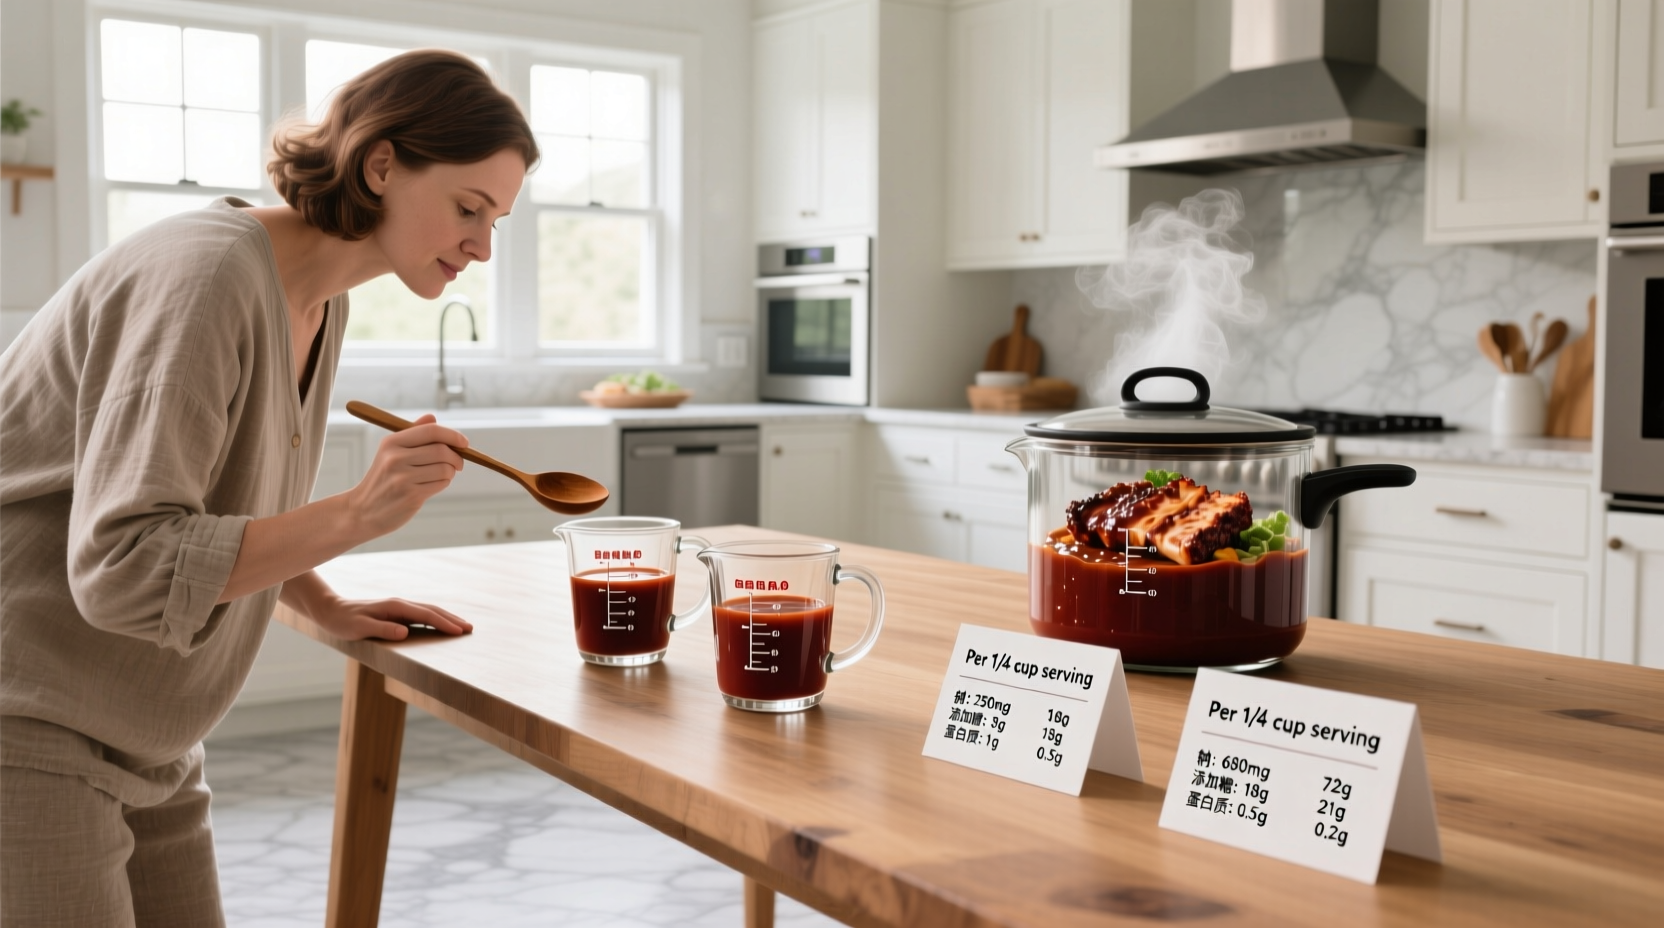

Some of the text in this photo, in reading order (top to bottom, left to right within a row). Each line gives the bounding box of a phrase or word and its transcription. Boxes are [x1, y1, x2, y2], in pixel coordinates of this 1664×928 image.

[965, 649, 1094, 690] Per 1/4 cup serving
[973, 694, 1011, 716] 250mg
[1208, 700, 1381, 754] Per 1/4 cup serving
[1036, 746, 1063, 767] 0.5g
[1221, 755, 1271, 782] 680mg
[1244, 783, 1269, 804] 18g
[1322, 776, 1352, 800] 72g
[1237, 803, 1268, 827] 0.5g
[1317, 799, 1346, 822] 21g
[1314, 822, 1349, 847] 0.2g
